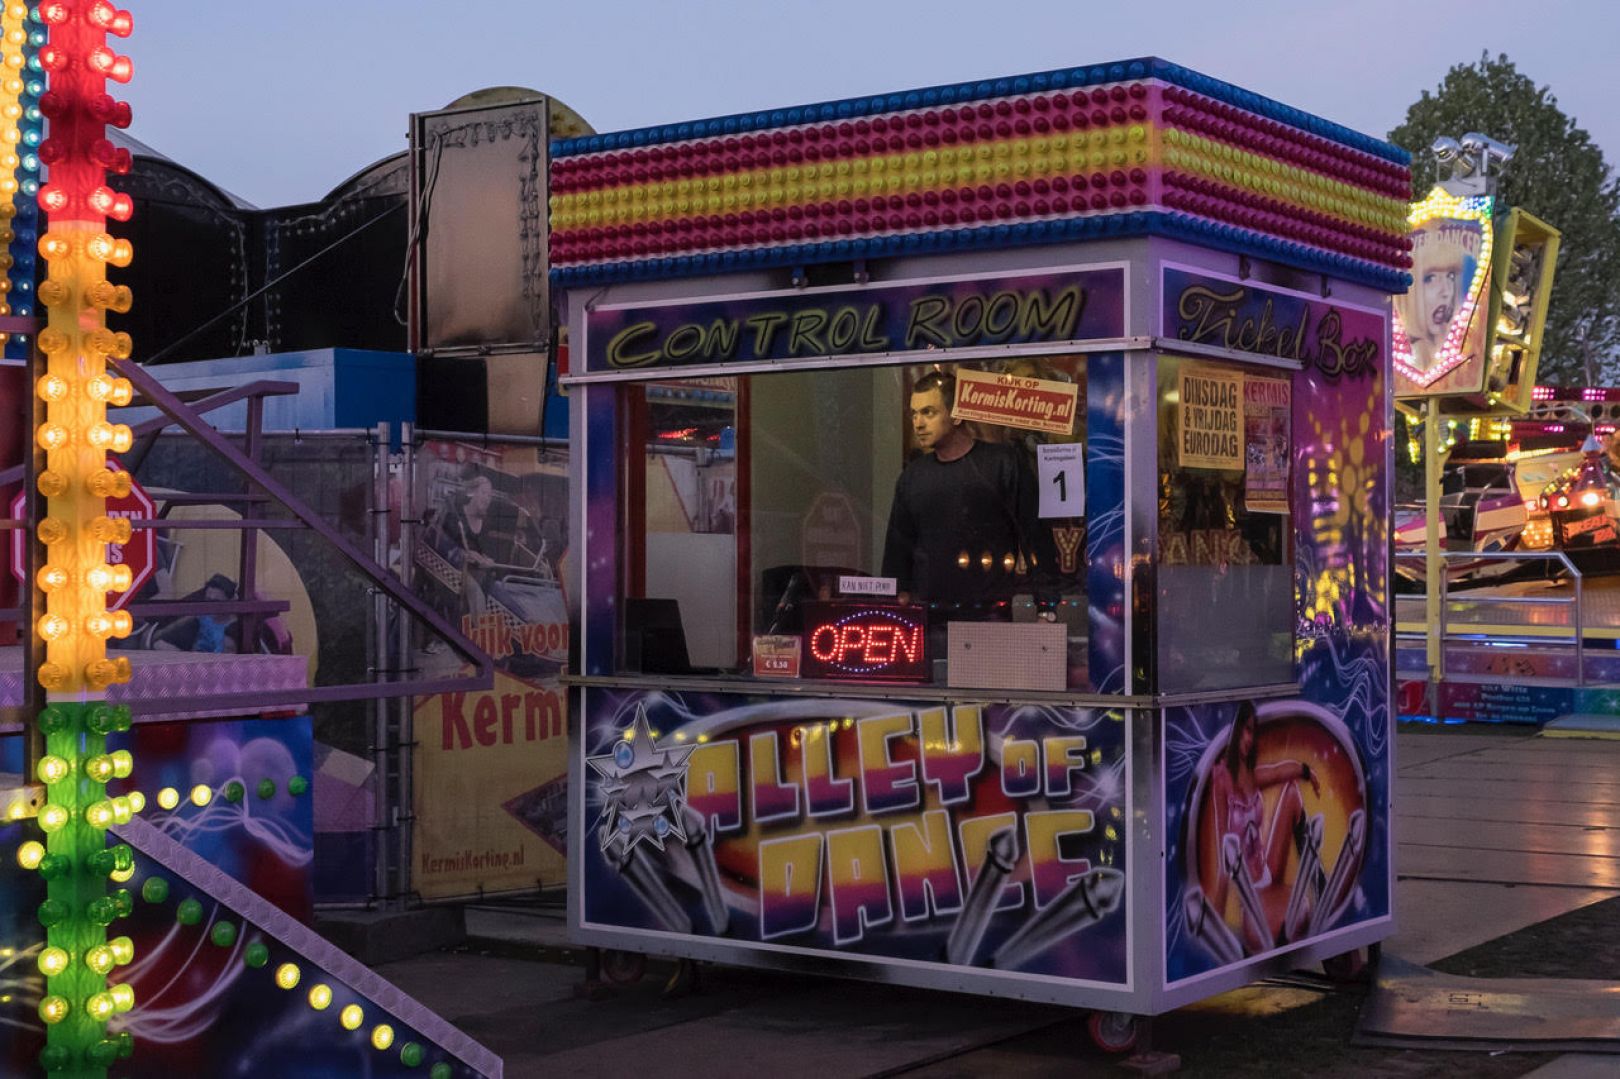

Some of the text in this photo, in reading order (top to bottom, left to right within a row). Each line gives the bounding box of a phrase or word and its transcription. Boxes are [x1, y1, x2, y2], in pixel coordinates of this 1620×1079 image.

[607, 284, 1087, 368] CONTROL ROOM
[1317, 307, 1378, 378] Box
[960, 382, 1072, 419] KermisKorting.nl
[1024, 380, 1040, 389] OP
[1184, 377, 1238, 409] DINSDAG
[1184, 406, 1191, 428] &
[1193, 409, 1237, 432] VRIJDAG
[1184, 430, 1239, 458] EURODAG
[1053, 470, 1067, 502] 1
[811, 624, 919, 662] OPEN
[685, 704, 1088, 838] ALLEY OF
[759, 809, 1095, 945] DANCE
